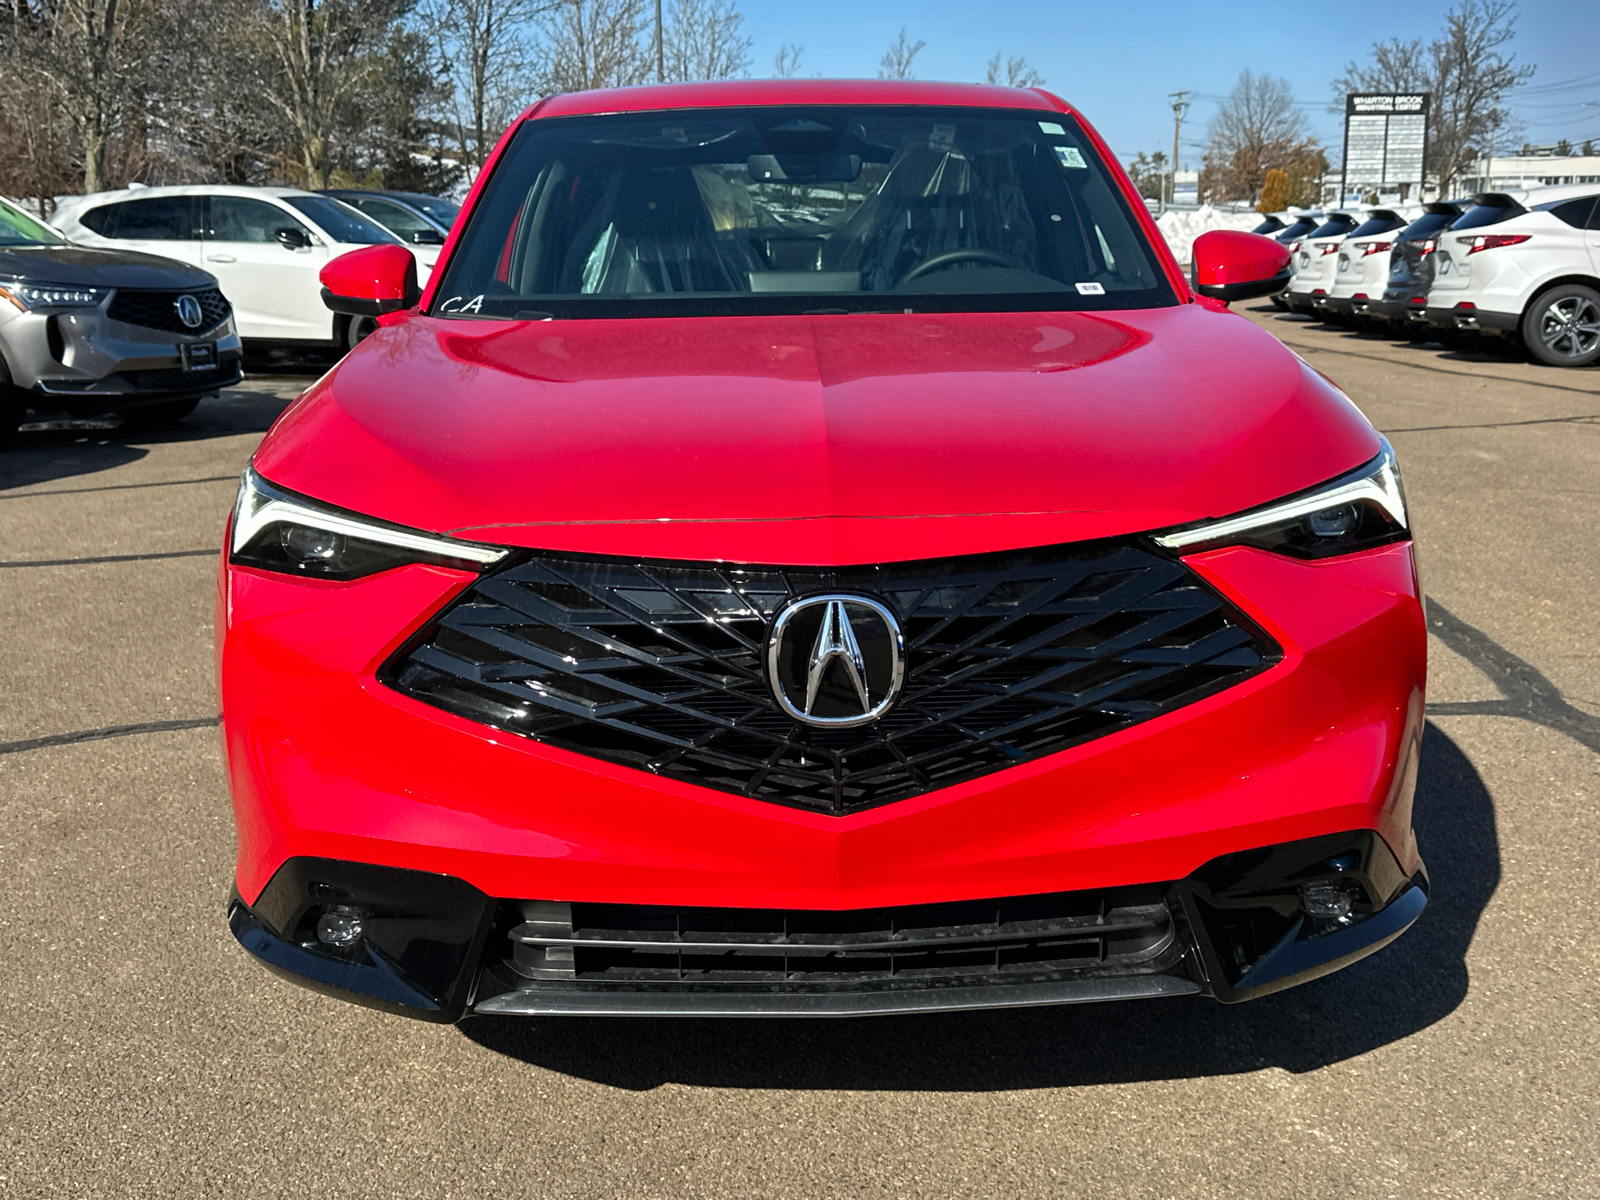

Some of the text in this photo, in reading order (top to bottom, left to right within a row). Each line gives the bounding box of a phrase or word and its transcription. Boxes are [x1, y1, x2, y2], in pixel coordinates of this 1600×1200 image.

[1353, 96, 1423, 105] WHARTON BROOK
[440, 294, 484, 314] CA
